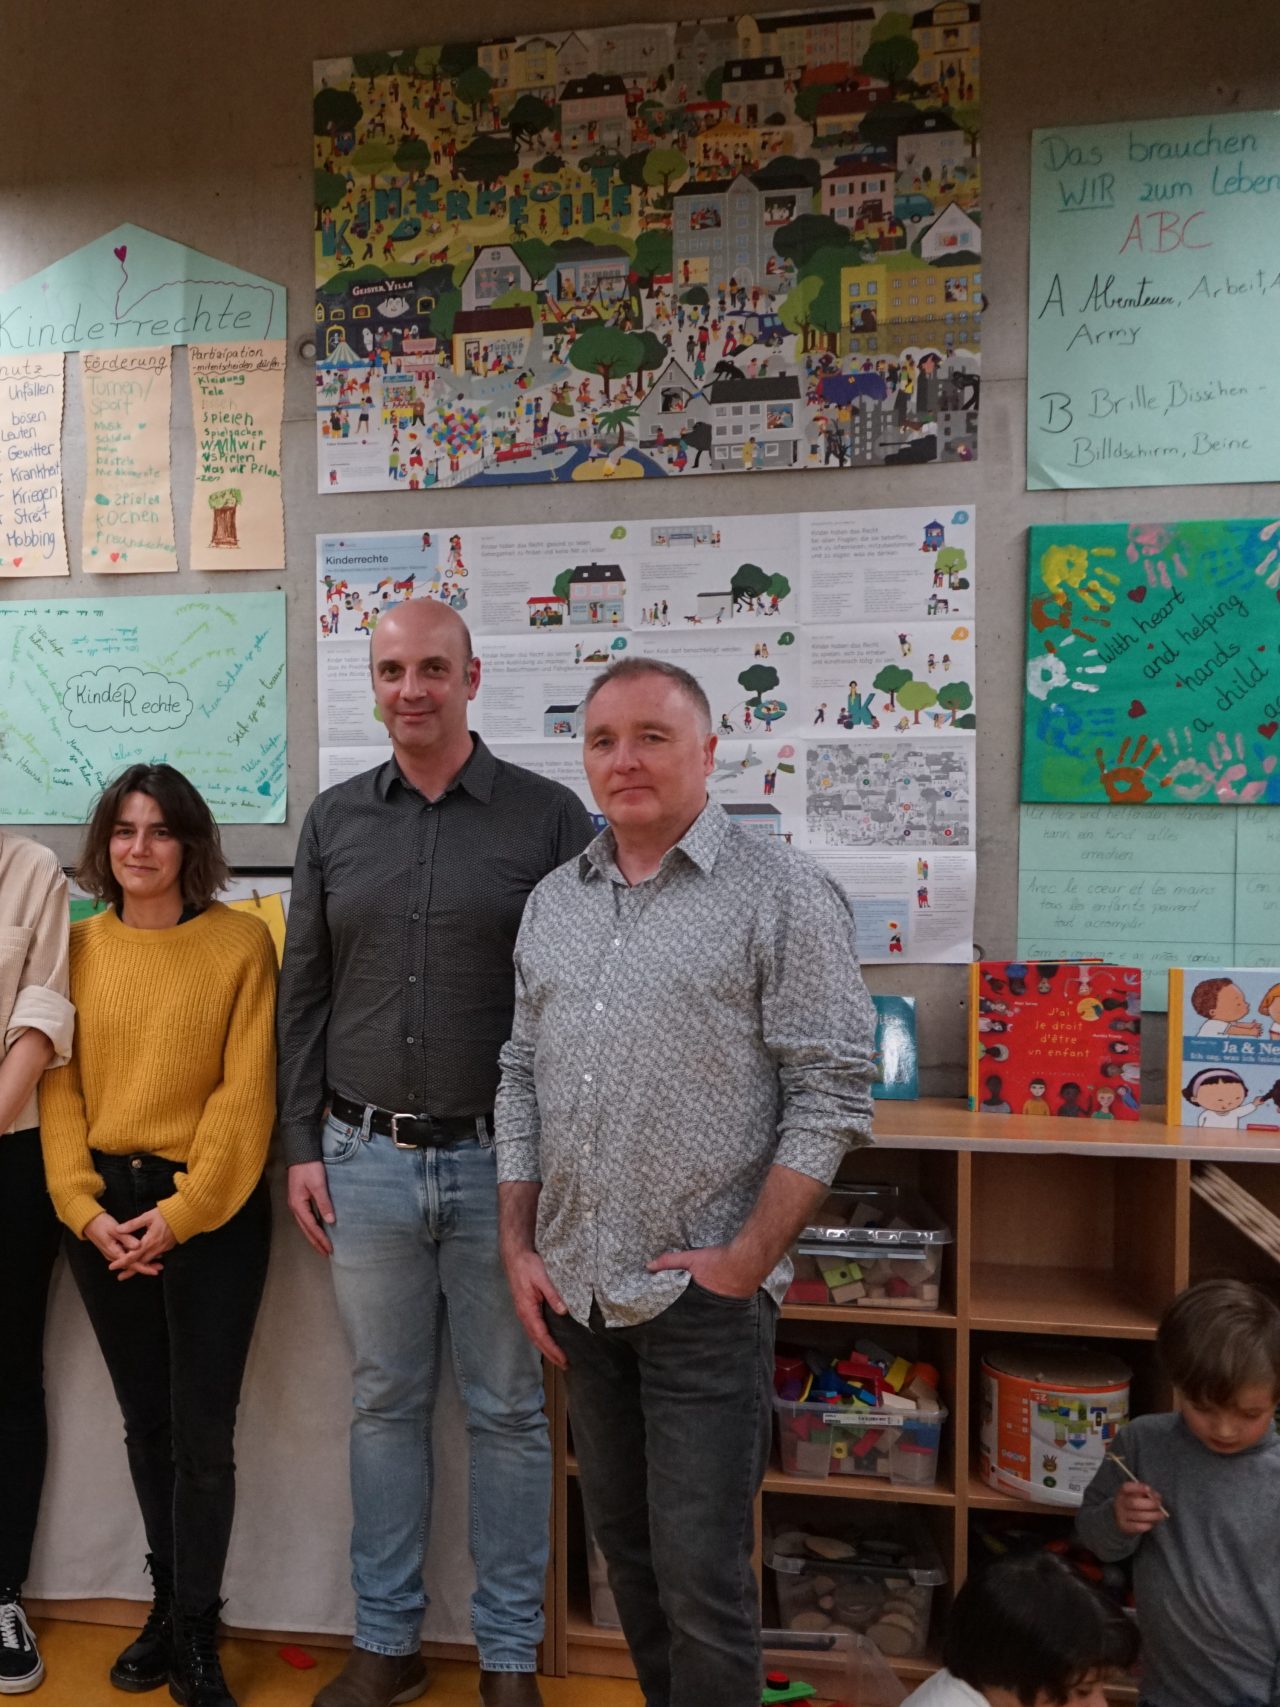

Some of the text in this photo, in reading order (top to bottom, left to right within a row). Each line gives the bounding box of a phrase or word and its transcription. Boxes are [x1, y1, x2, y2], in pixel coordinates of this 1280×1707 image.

[1041, 123, 1256, 172] Das brauchen
[1058, 173, 1115, 207] WIR
[1138, 181, 1192, 203] zum
[1119, 210, 1213, 255] ABC
[1038, 273, 1064, 319] A
[1066, 323, 1142, 351] Army
[84, 355, 167, 375] Förderung
[1039, 392, 1073, 434] B
[7, 443, 55, 461] Gewitter
[6, 532, 56, 559] Mobbing
[326, 555, 388, 564] Kinderrechte
[1133, 586, 1185, 639] heart
[1143, 594, 1249, 679] and helping
[1182, 642, 1241, 692] hands
[1193, 657, 1269, 733] a child
[1222, 1040, 1238, 1053] Ja
[1241, 1042, 1255, 1054] &
